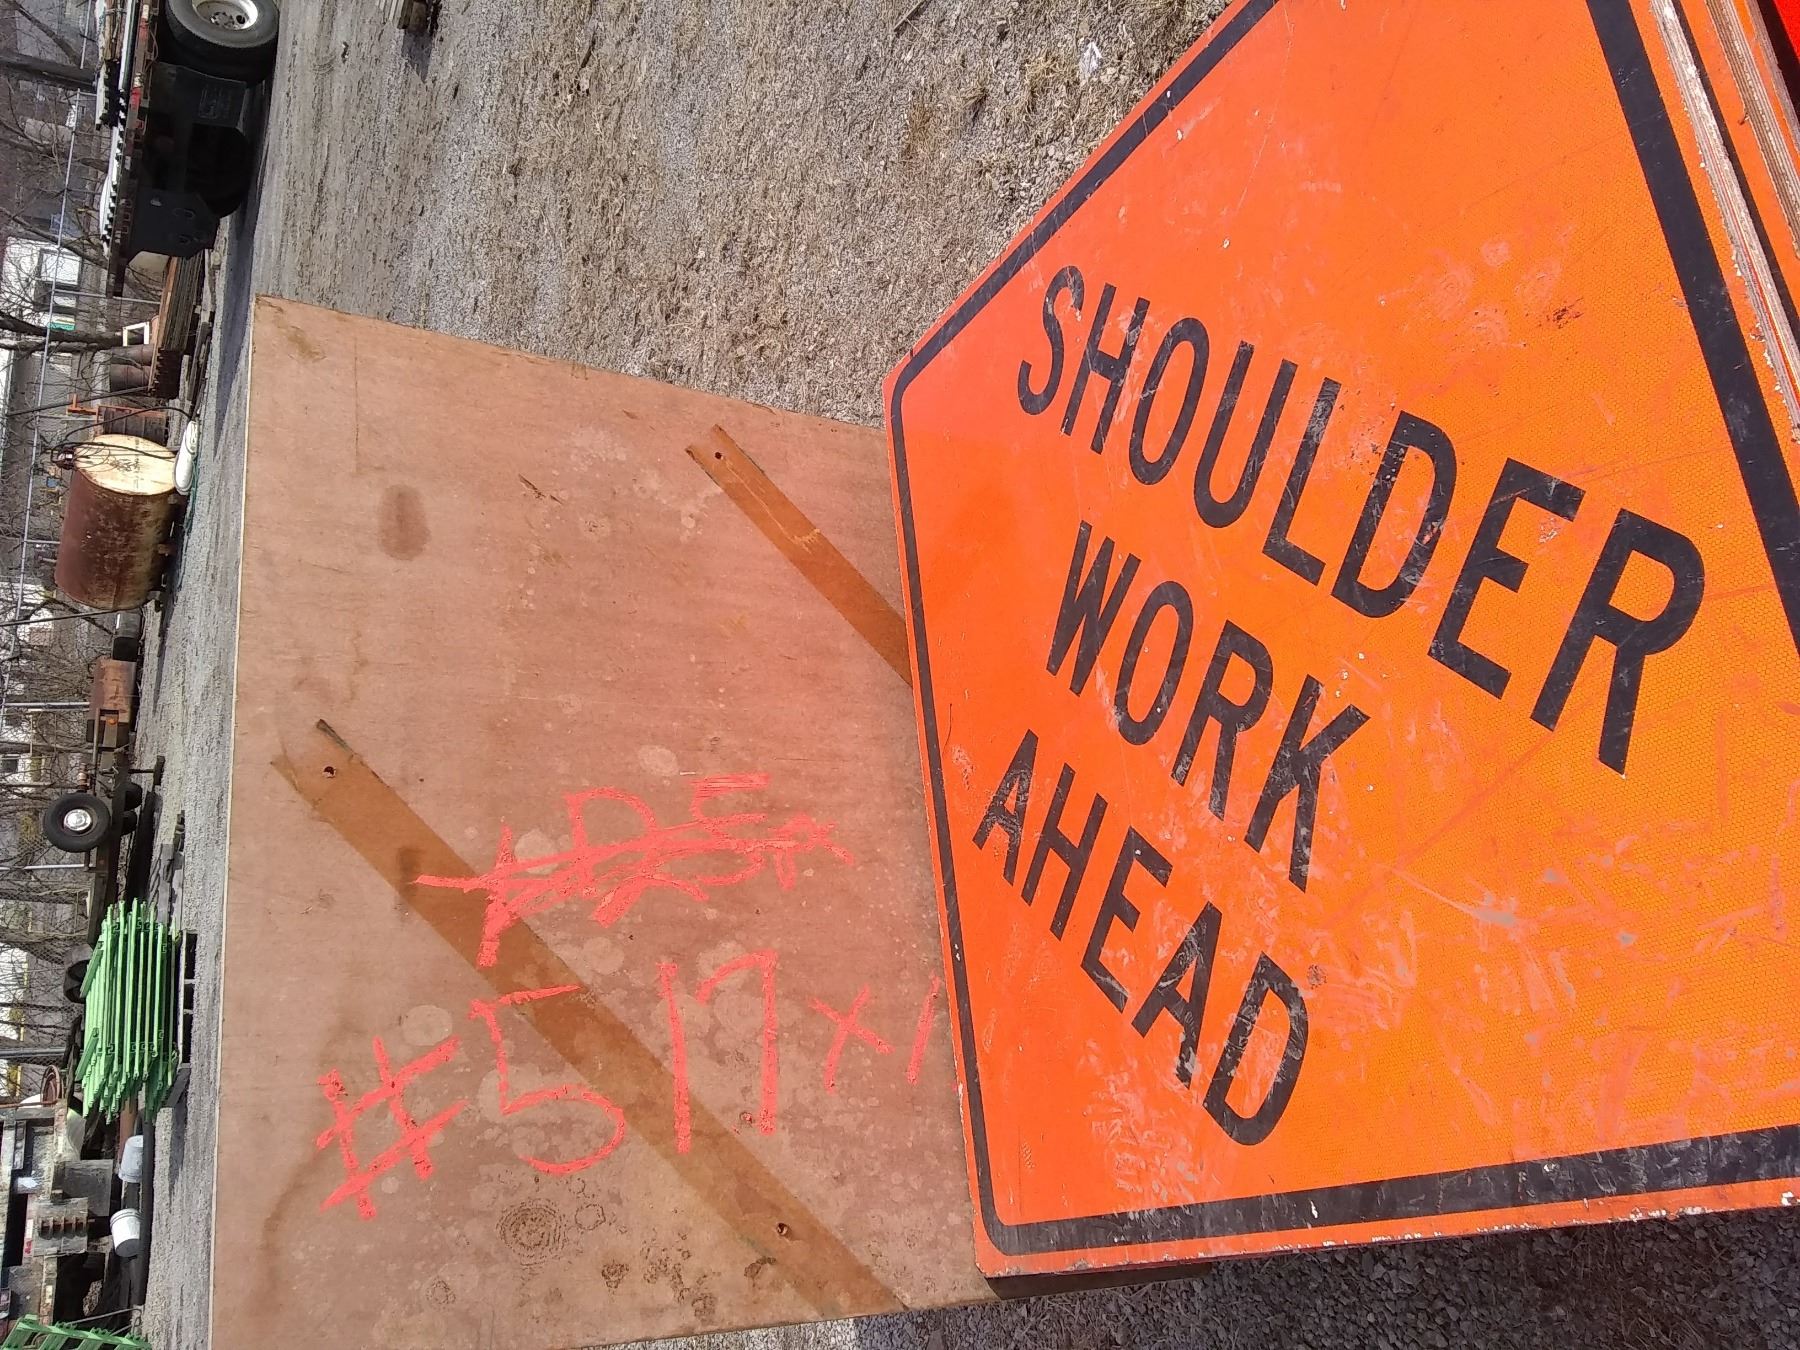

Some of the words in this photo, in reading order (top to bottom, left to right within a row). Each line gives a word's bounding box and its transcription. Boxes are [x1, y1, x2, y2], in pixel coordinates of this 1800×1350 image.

[1017, 264, 1706, 776] SHOULDER
[1046, 519, 1371, 893] WORK
[972, 729, 1309, 1146] AHEAD
